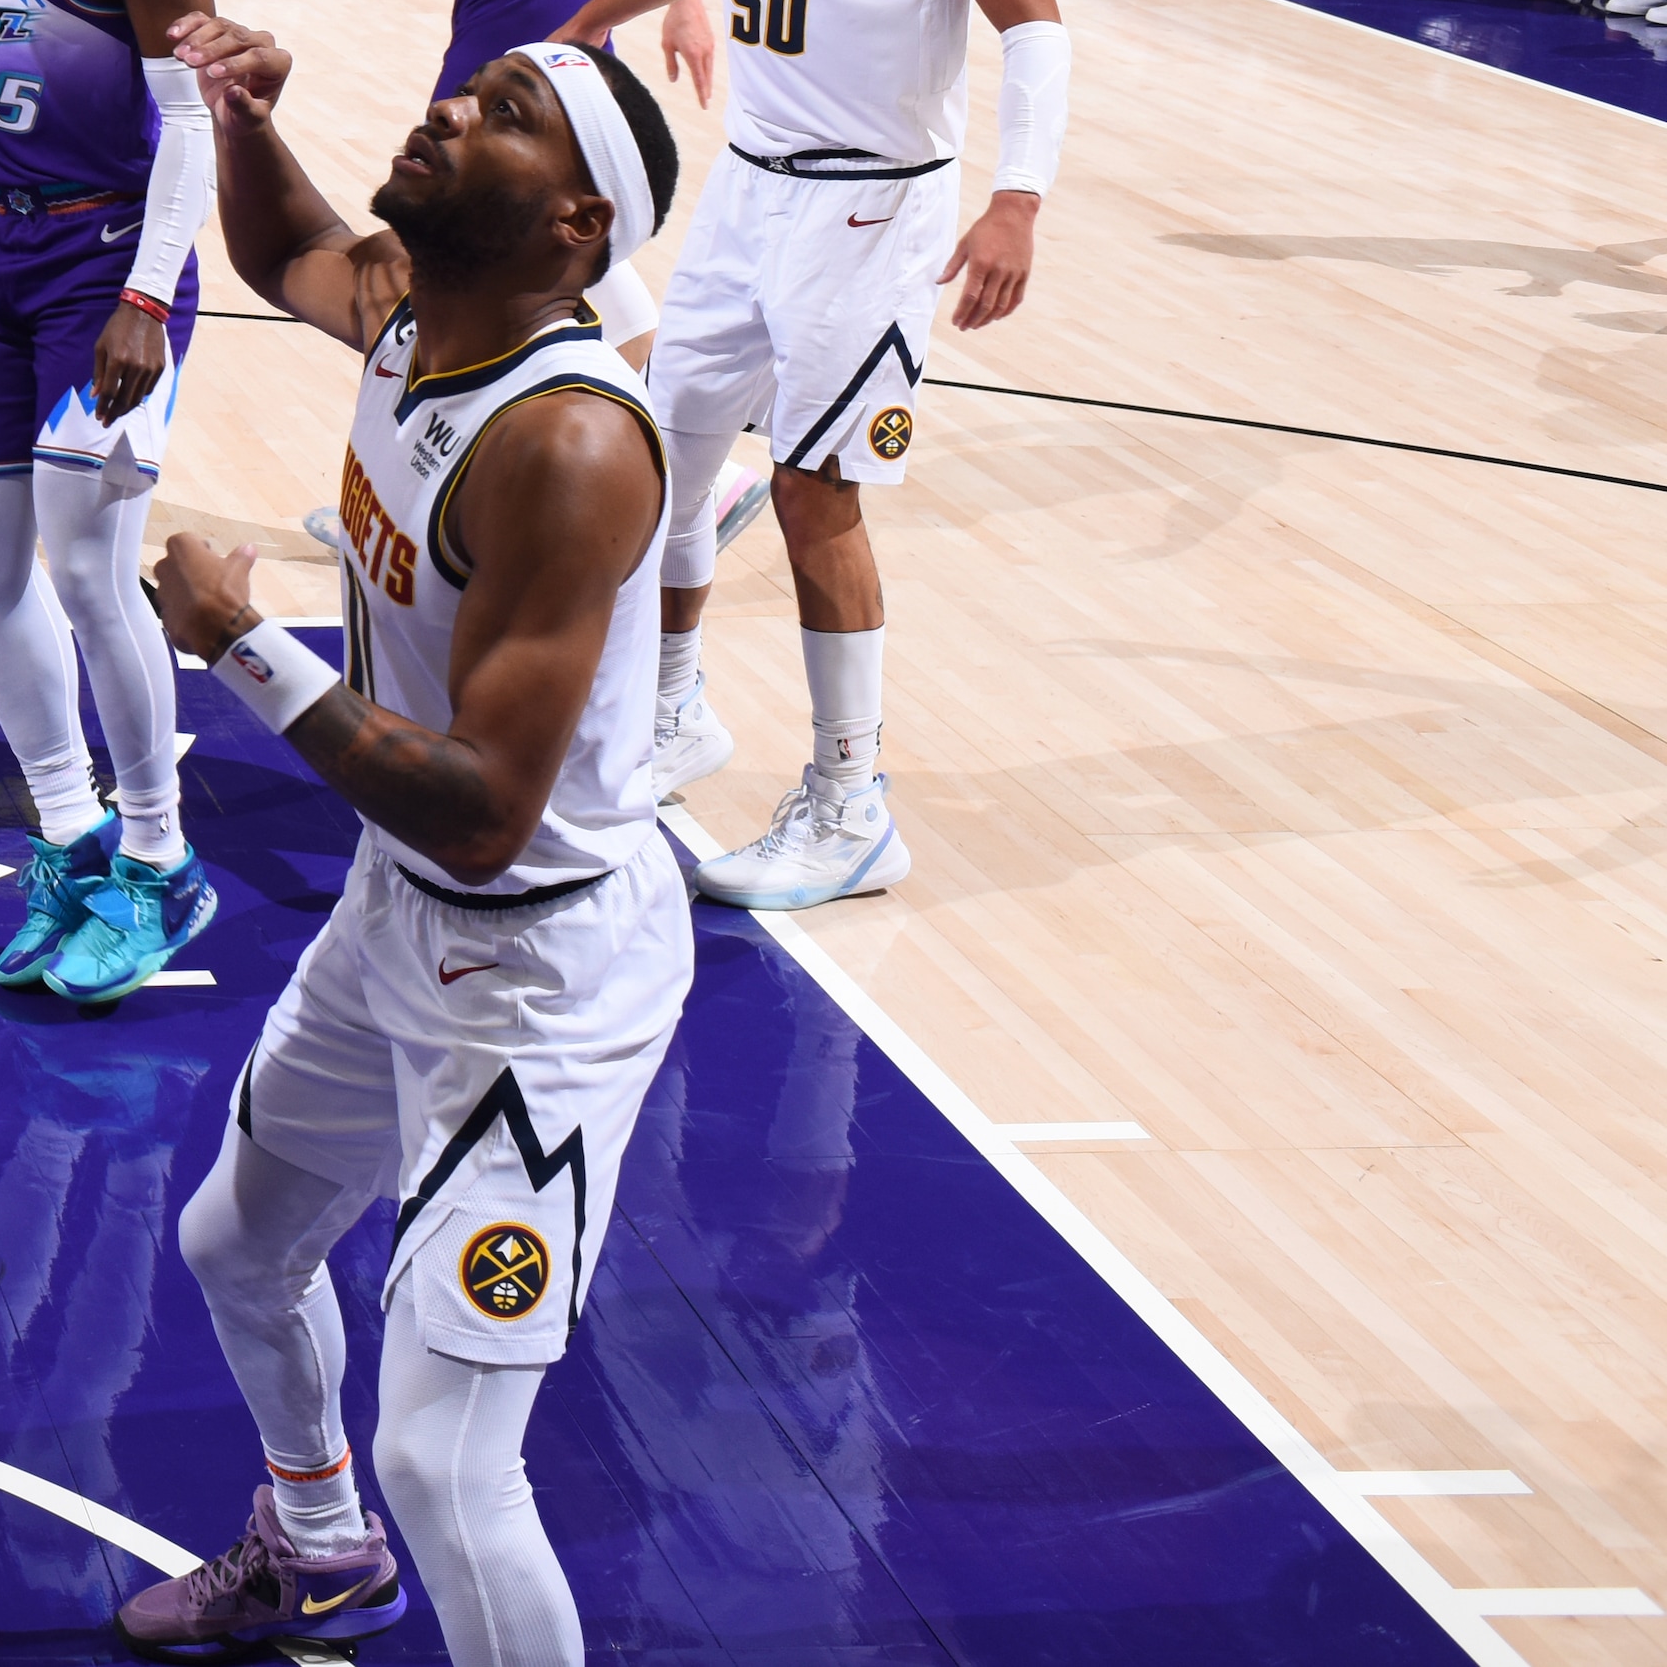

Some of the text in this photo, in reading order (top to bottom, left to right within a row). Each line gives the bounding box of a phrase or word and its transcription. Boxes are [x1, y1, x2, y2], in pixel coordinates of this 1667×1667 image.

[425, 412, 461, 458] WU
[409, 457, 431, 481] Union
[413, 437, 442, 473] Western
